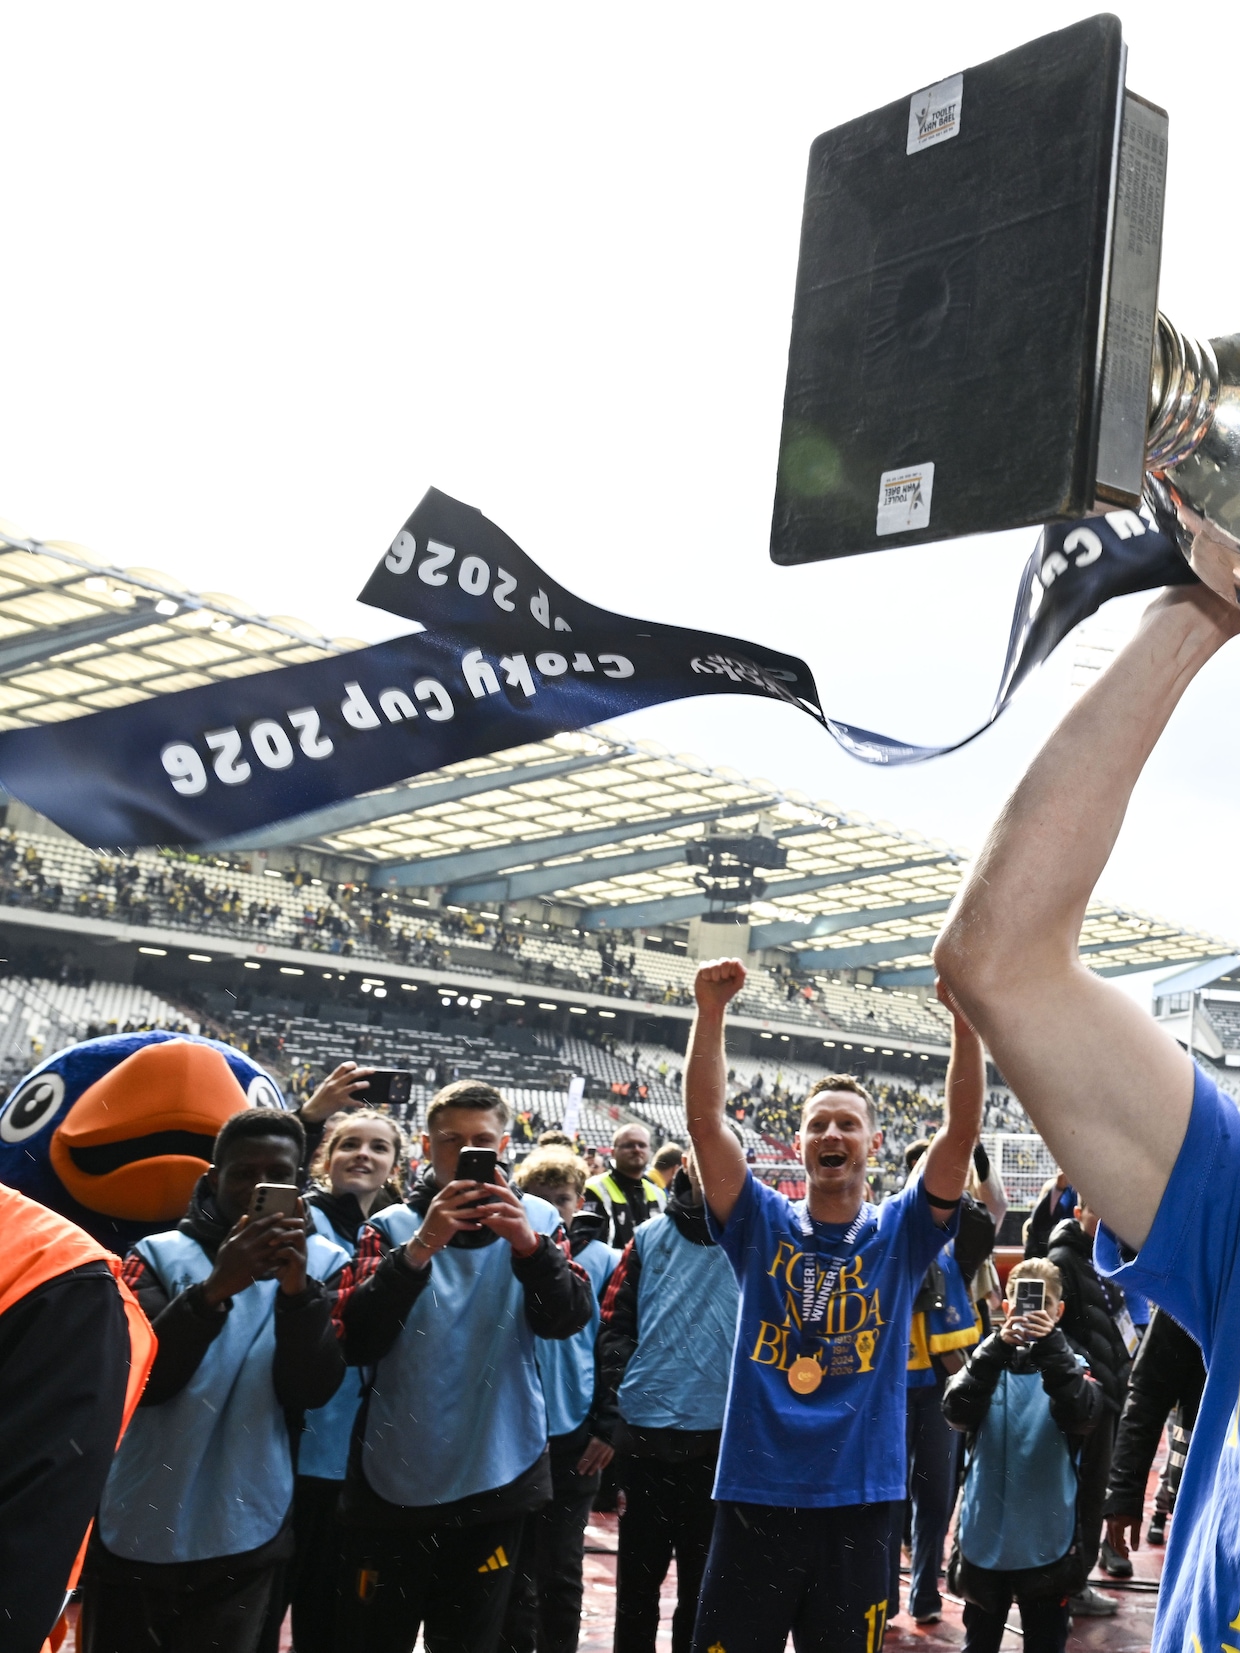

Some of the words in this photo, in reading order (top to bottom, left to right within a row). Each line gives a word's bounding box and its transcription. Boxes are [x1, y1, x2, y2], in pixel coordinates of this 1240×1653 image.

[384, 530, 518, 612] 2026
[461, 647, 635, 698] Croky
[341, 678, 455, 731] Cup
[161, 706, 334, 796] 2026
[810, 1270, 838, 1322] WINNER
